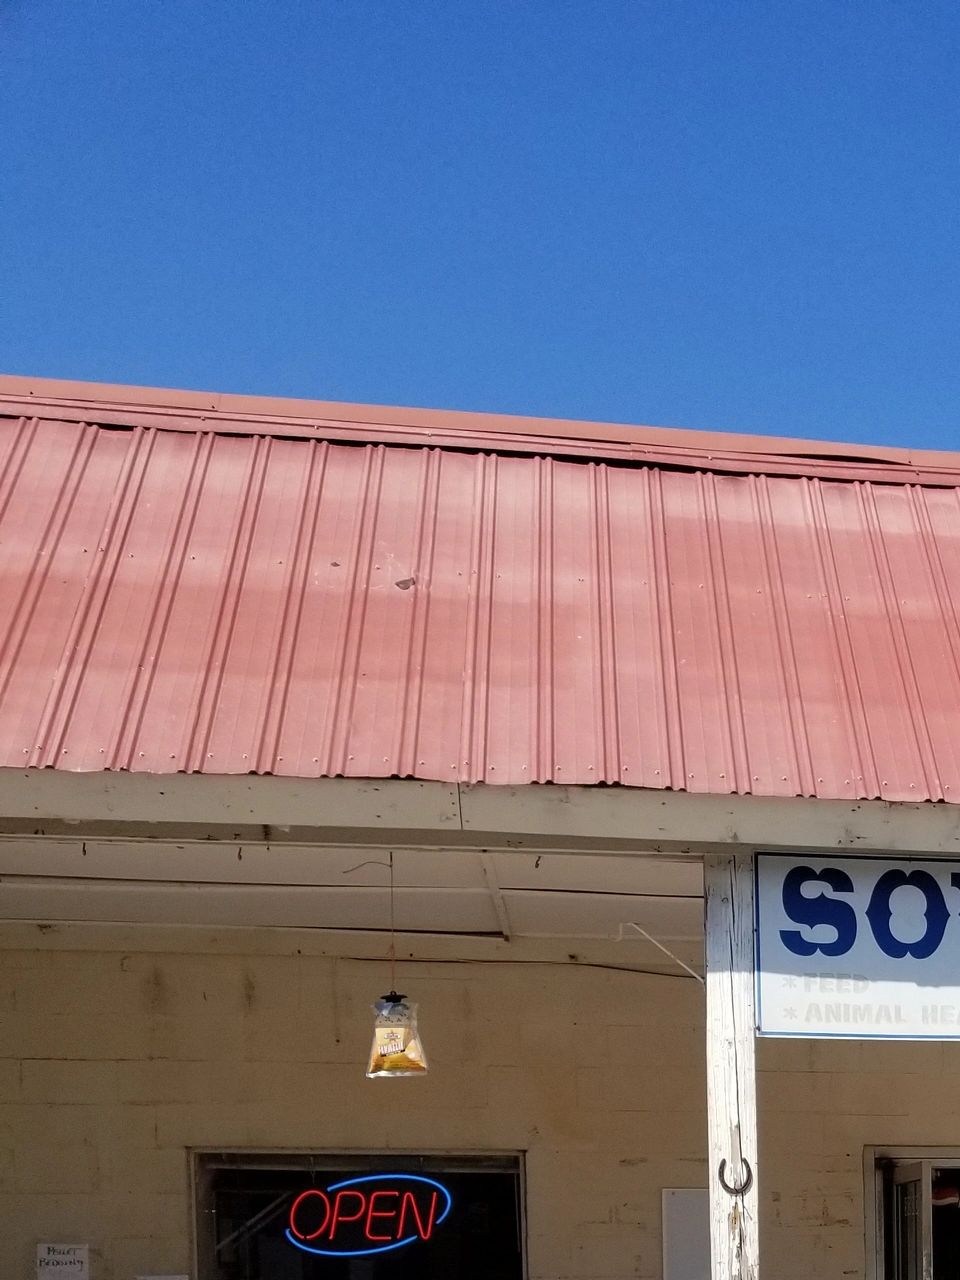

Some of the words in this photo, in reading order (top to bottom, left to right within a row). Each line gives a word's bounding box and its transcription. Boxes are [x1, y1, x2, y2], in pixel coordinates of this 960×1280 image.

[804, 973, 869, 994] FEED
[804, 1002, 906, 1025] ANIMAL
[290, 1190, 438, 1240] OPEN
